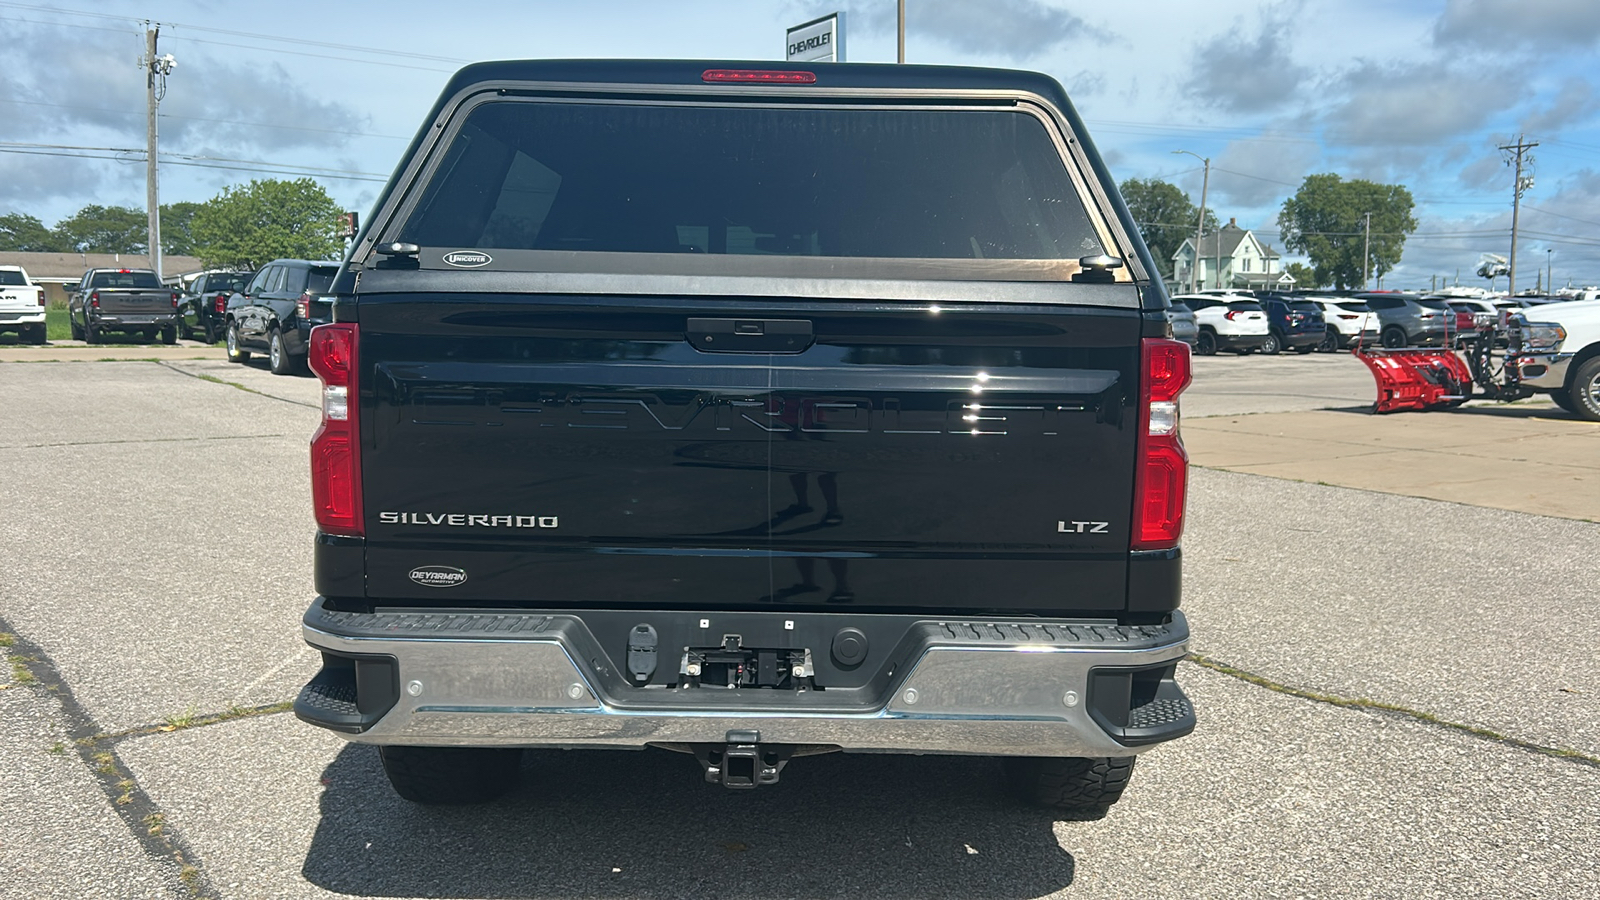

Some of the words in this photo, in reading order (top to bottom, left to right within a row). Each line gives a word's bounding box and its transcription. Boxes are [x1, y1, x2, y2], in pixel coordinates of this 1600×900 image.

[789, 32, 832, 56] CHEVROLET
[449, 254, 487, 263] UNICOVER
[379, 511, 559, 528] SILVERADO
[1057, 520, 1109, 534] LTZ
[412, 571, 465, 581] DEYARMAN
